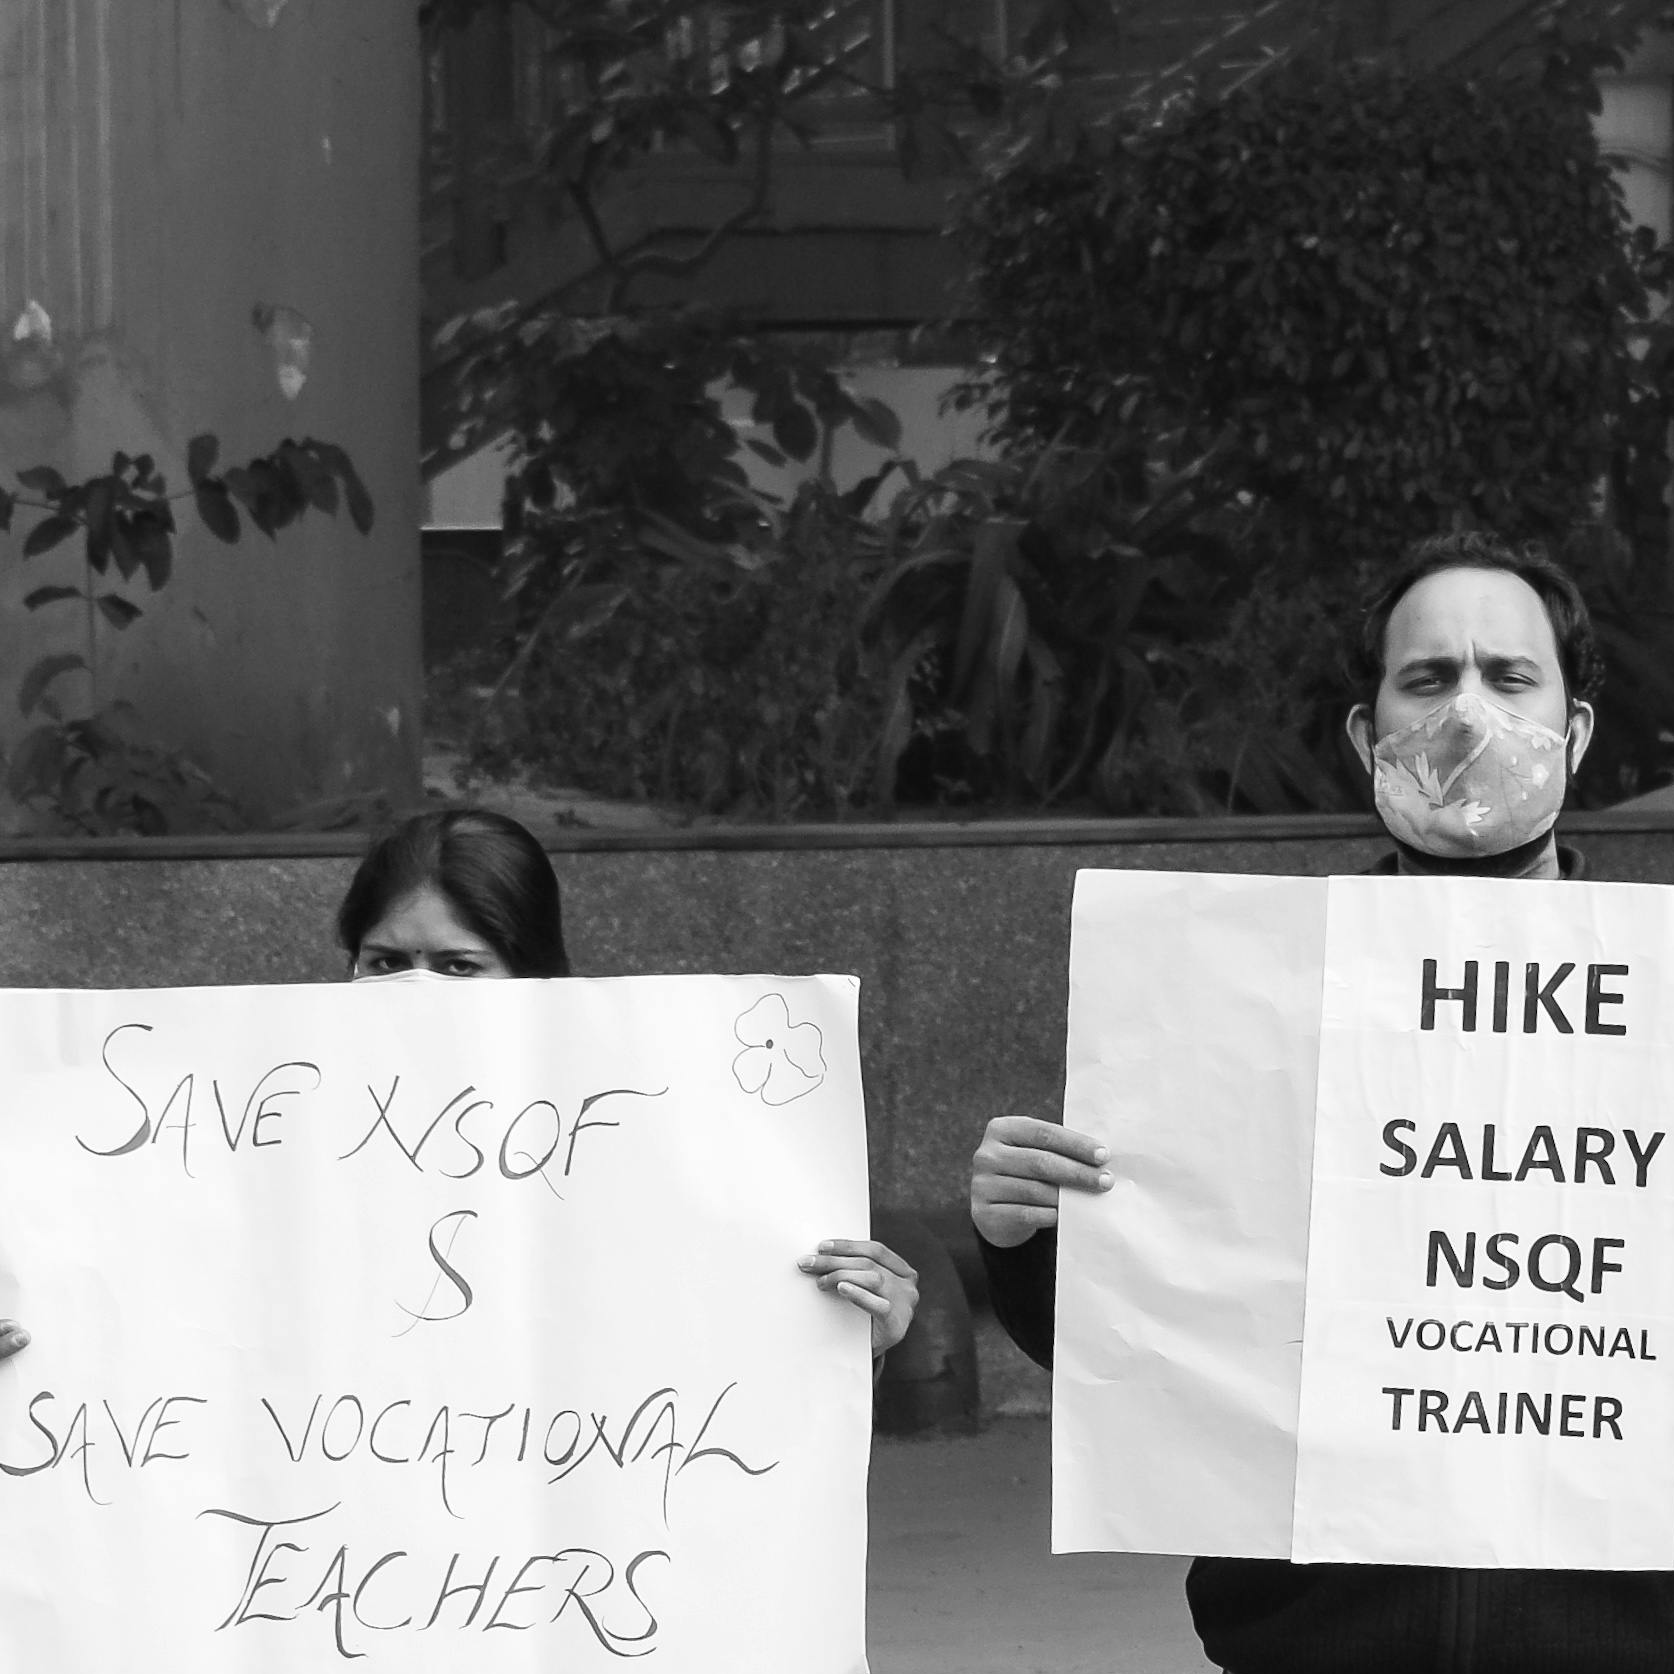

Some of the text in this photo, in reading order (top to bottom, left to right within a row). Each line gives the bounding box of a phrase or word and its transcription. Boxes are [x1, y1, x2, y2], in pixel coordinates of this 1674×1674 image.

[1420, 958, 1630, 1036] HIKE
[75, 1023, 669, 1200] SAVE NSQF
[1379, 1118, 1667, 1188] SALARY
[1426, 1229, 1626, 1303] NSQF
[1386, 1316, 1658, 1362] VOCATIONAL
[1382, 1387, 1625, 1441] TRAINER
[0, 1382, 780, 1530] SAVE VOCATIONAL
[196, 1501, 672, 1659] TEACHERS
